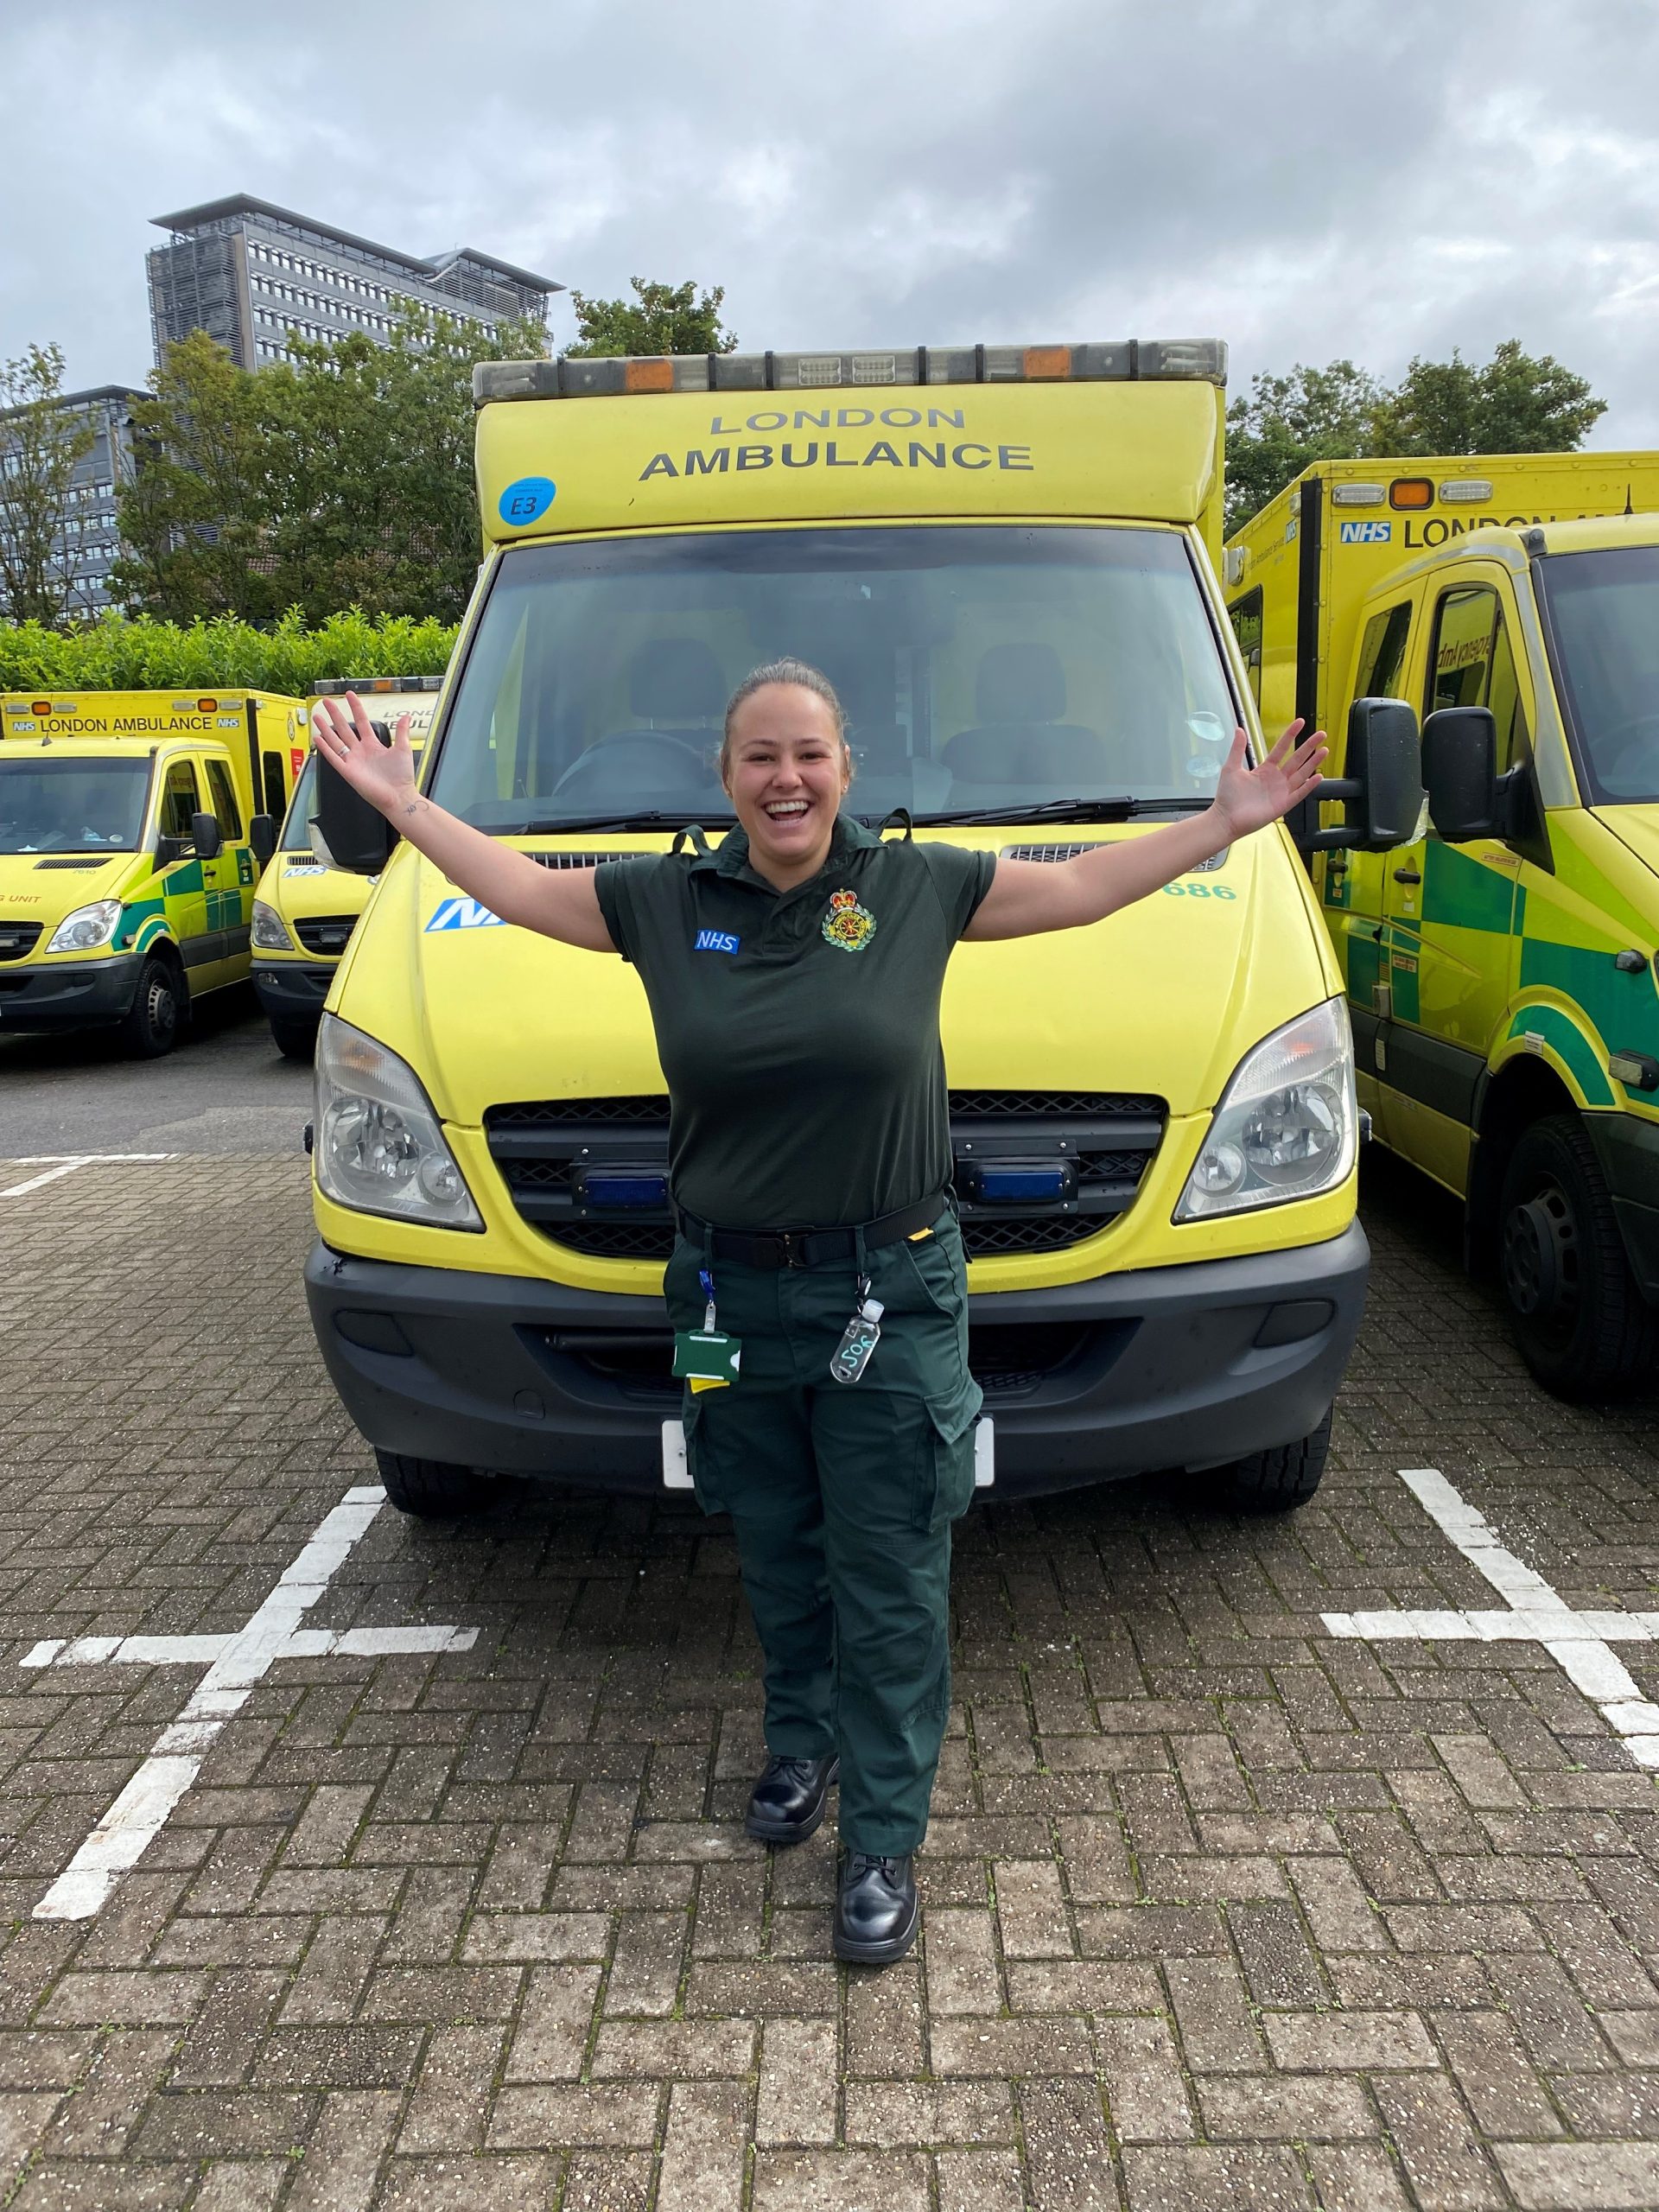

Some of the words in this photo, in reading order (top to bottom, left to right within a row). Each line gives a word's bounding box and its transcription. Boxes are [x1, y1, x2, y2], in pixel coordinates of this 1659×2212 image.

[710, 408, 964, 435] LONDON
[639, 442, 1033, 480] AMBULANCE
[511, 497, 537, 515] E3
[1342, 522, 1389, 543] NHS
[13, 722, 35, 731] NHS
[41, 720, 107, 733] LONDON
[113, 717, 213, 731] AMBULANCE
[218, 719, 239, 728] NHS
[283, 867, 327, 877] NHS
[1162, 882, 1236, 899] 686
[697, 931, 736, 950] NHS
